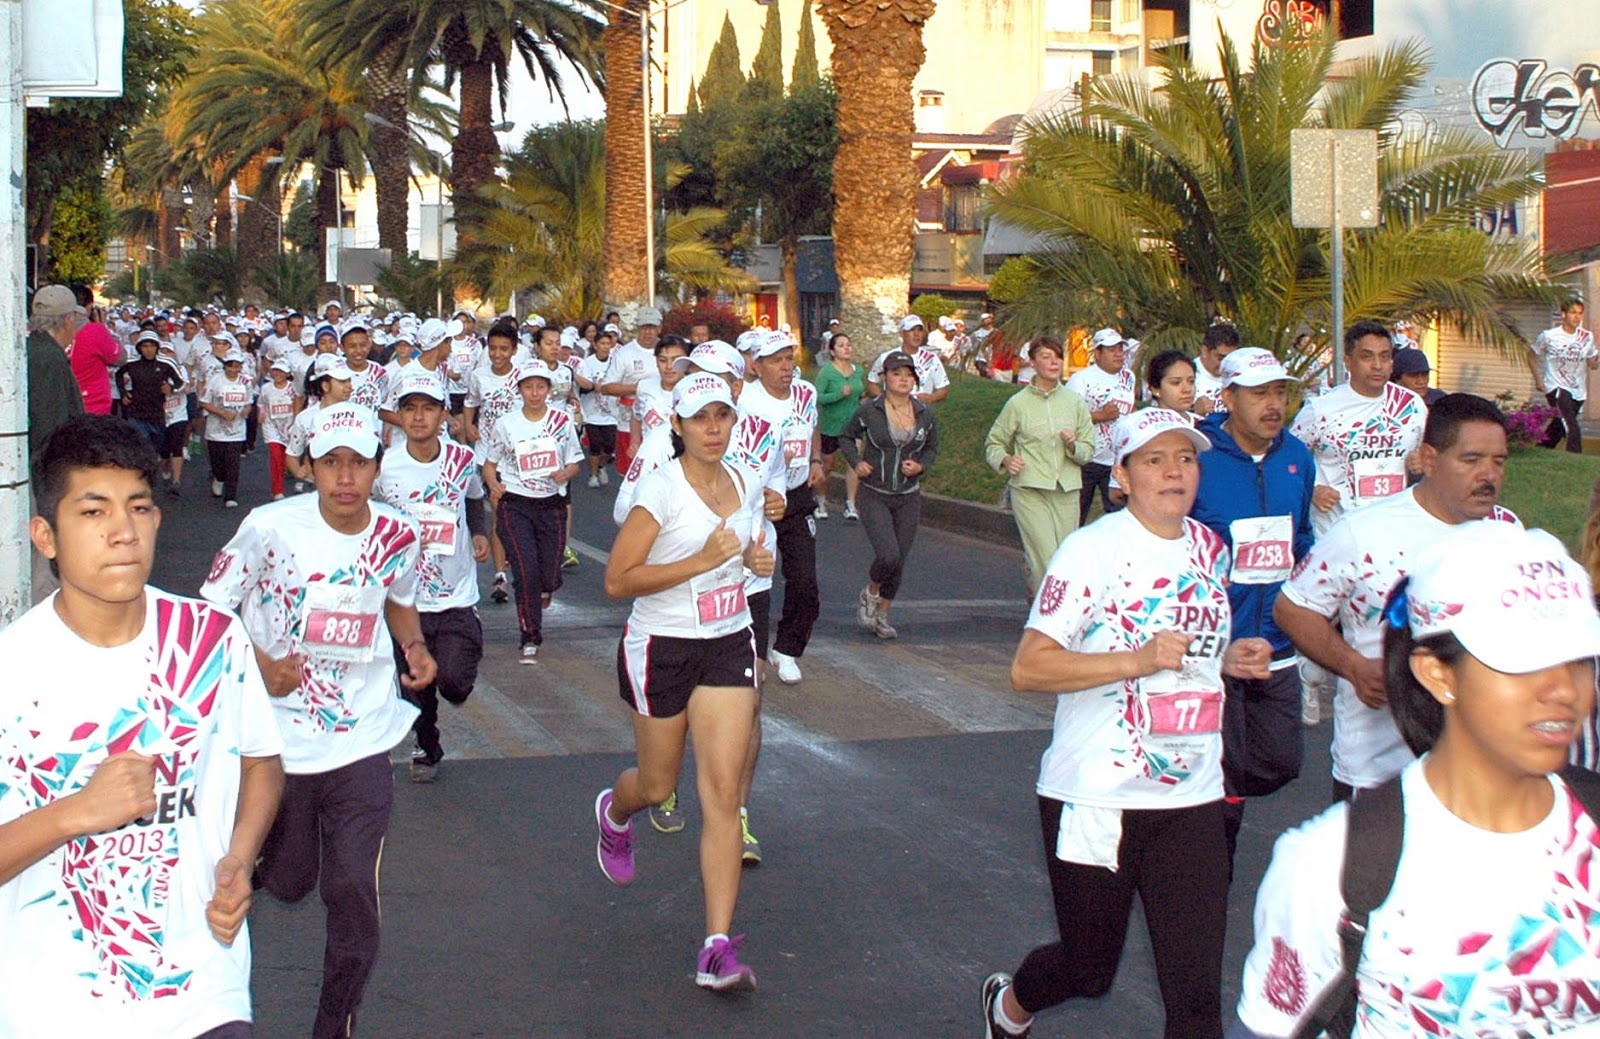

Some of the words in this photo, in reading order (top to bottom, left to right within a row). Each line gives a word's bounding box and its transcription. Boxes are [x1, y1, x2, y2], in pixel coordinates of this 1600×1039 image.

[688, 382, 724, 395] ONCEK
[331, 411, 355, 420] IPN
[1138, 415, 1185, 430] ONCEK
[322, 419, 363, 431] ONCEK
[1359, 434, 1394, 449] IPN
[525, 453, 551, 469] 1377
[1349, 448, 1406, 461] ONCEK
[1374, 478, 1390, 495] 53
[1246, 544, 1284, 567] 1258
[1501, 581, 1585, 607] ONCEK
[714, 588, 739, 618] 177
[1169, 606, 1219, 632] IPN
[322, 616, 361, 644] 838
[1174, 698, 1202, 731] 77
[103, 830, 164, 860] 2013
